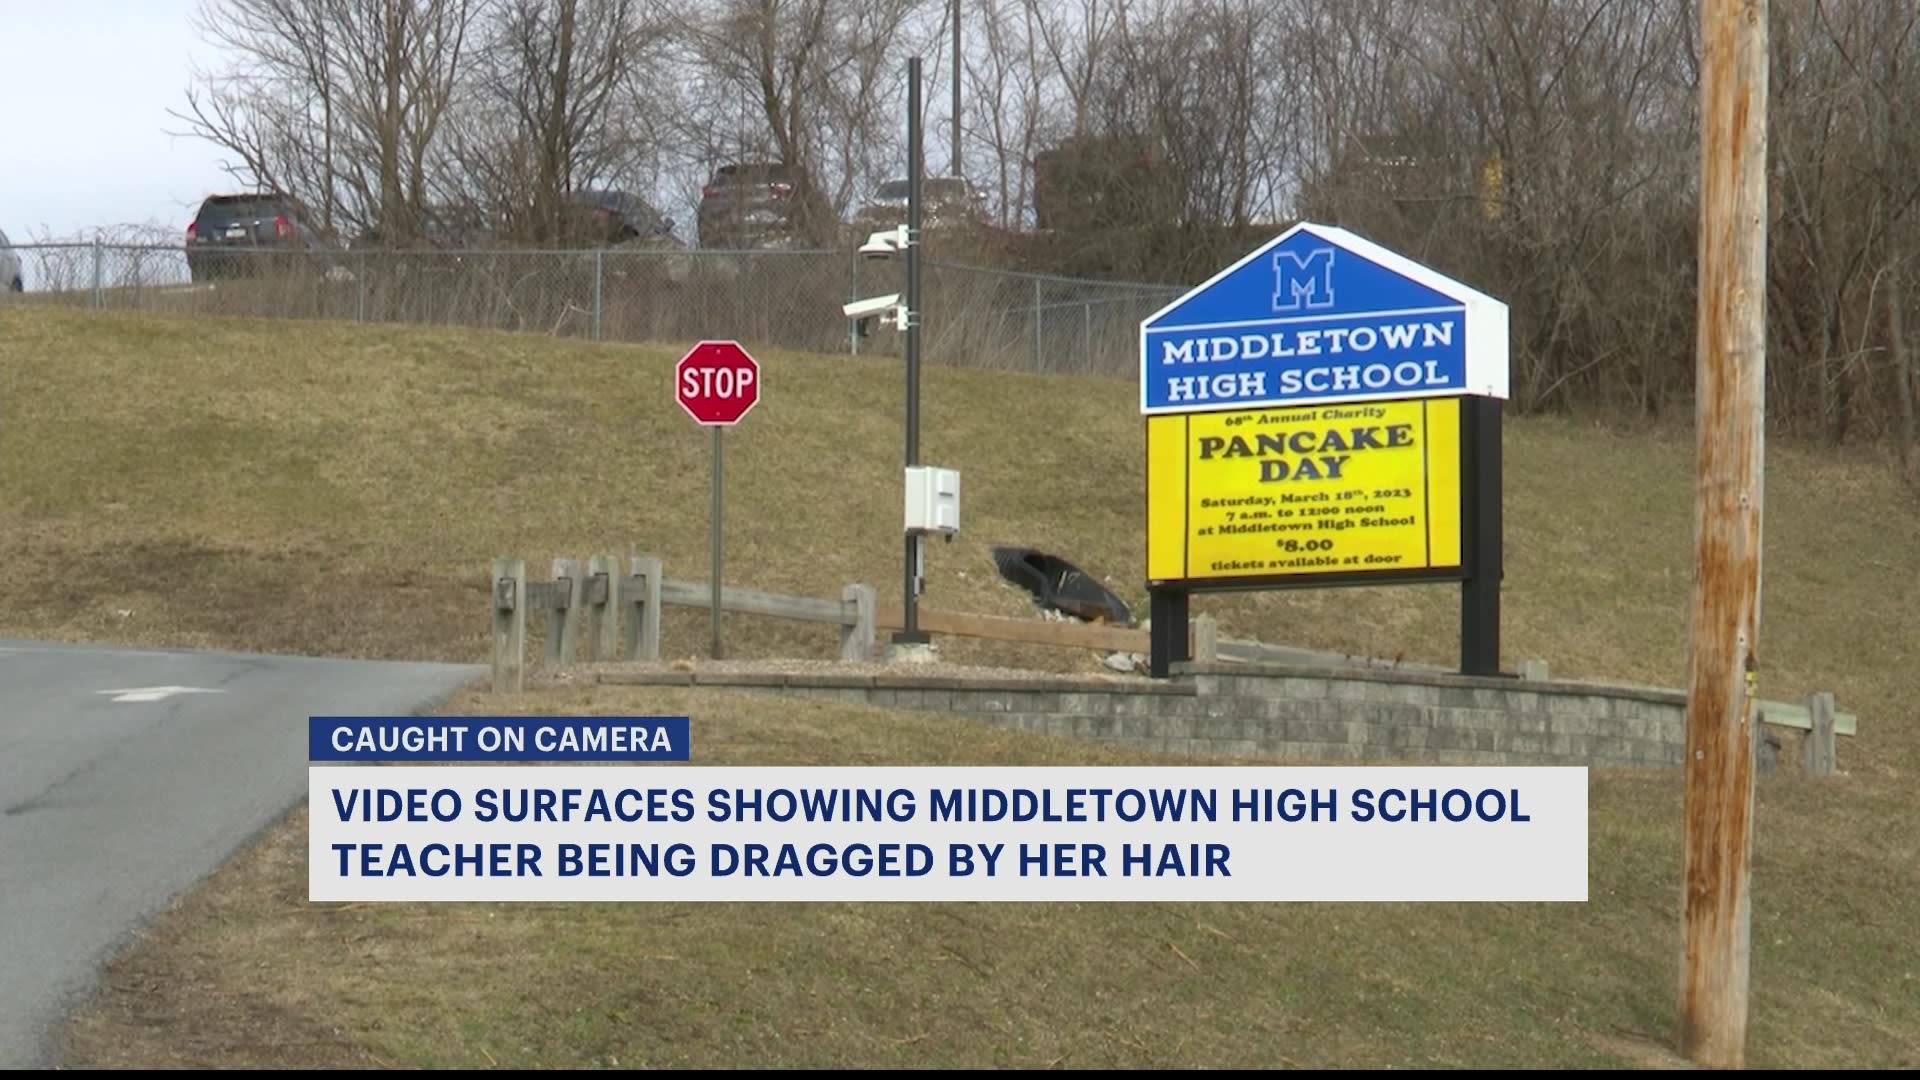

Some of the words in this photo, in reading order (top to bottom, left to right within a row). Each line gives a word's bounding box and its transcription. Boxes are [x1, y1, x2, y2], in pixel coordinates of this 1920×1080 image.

[1272, 248, 1334, 311] M
[1162, 322, 1454, 364] MIDDLETOWN
[682, 366, 754, 399] STOP
[1167, 372, 1266, 401] HIGH
[1280, 360, 1449, 393] SCHOOL
[1257, 411, 1317, 425] Annual
[1321, 407, 1387, 420] Charity
[1198, 423, 1415, 460] PANCAKE
[1258, 455, 1351, 483] DAY
[1200, 495, 1277, 509] Saturday,
[1280, 491, 1330, 504] March
[1373, 487, 1412, 499] 2023
[1197, 525, 1215, 536] at
[1218, 519, 1313, 535] Middletown
[1317, 517, 1356, 532] High
[1360, 515, 1416, 528] School
[1225, 511, 1235, 522] 7
[1238, 511, 1272, 520] a.m.
[1276, 508, 1294, 518] to
[1298, 506, 1341, 517] 12:00
[1344, 504, 1385, 515] noon
[1276, 538, 1334, 553] $8.00
[1211, 560, 1265, 572] tickets
[1269, 556, 1339, 569] available
[1343, 555, 1361, 566] at
[1364, 552, 1403, 564] door
